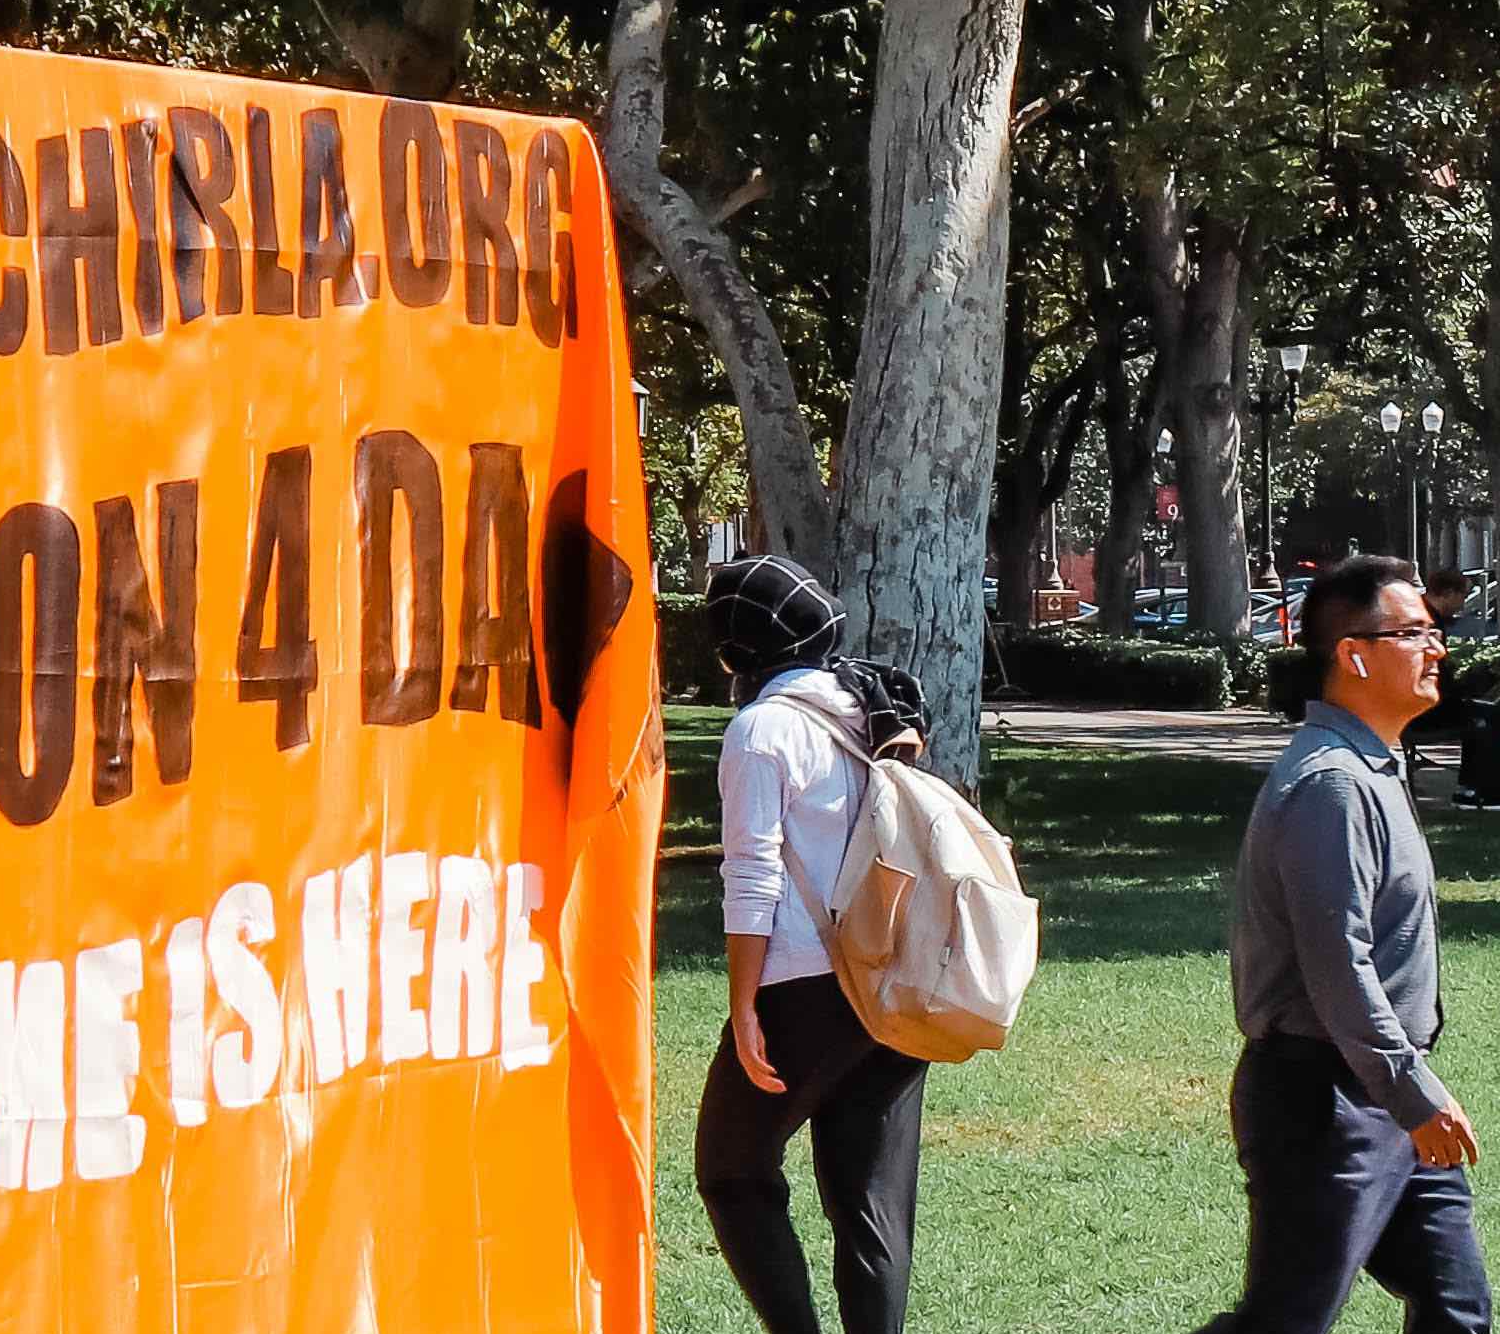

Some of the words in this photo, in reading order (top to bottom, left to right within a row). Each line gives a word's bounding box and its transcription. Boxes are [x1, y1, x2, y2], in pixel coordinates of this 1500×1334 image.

[237, 445, 318, 755] 4
[164, 881, 283, 1127] IS
[301, 851, 553, 1084] HERE
